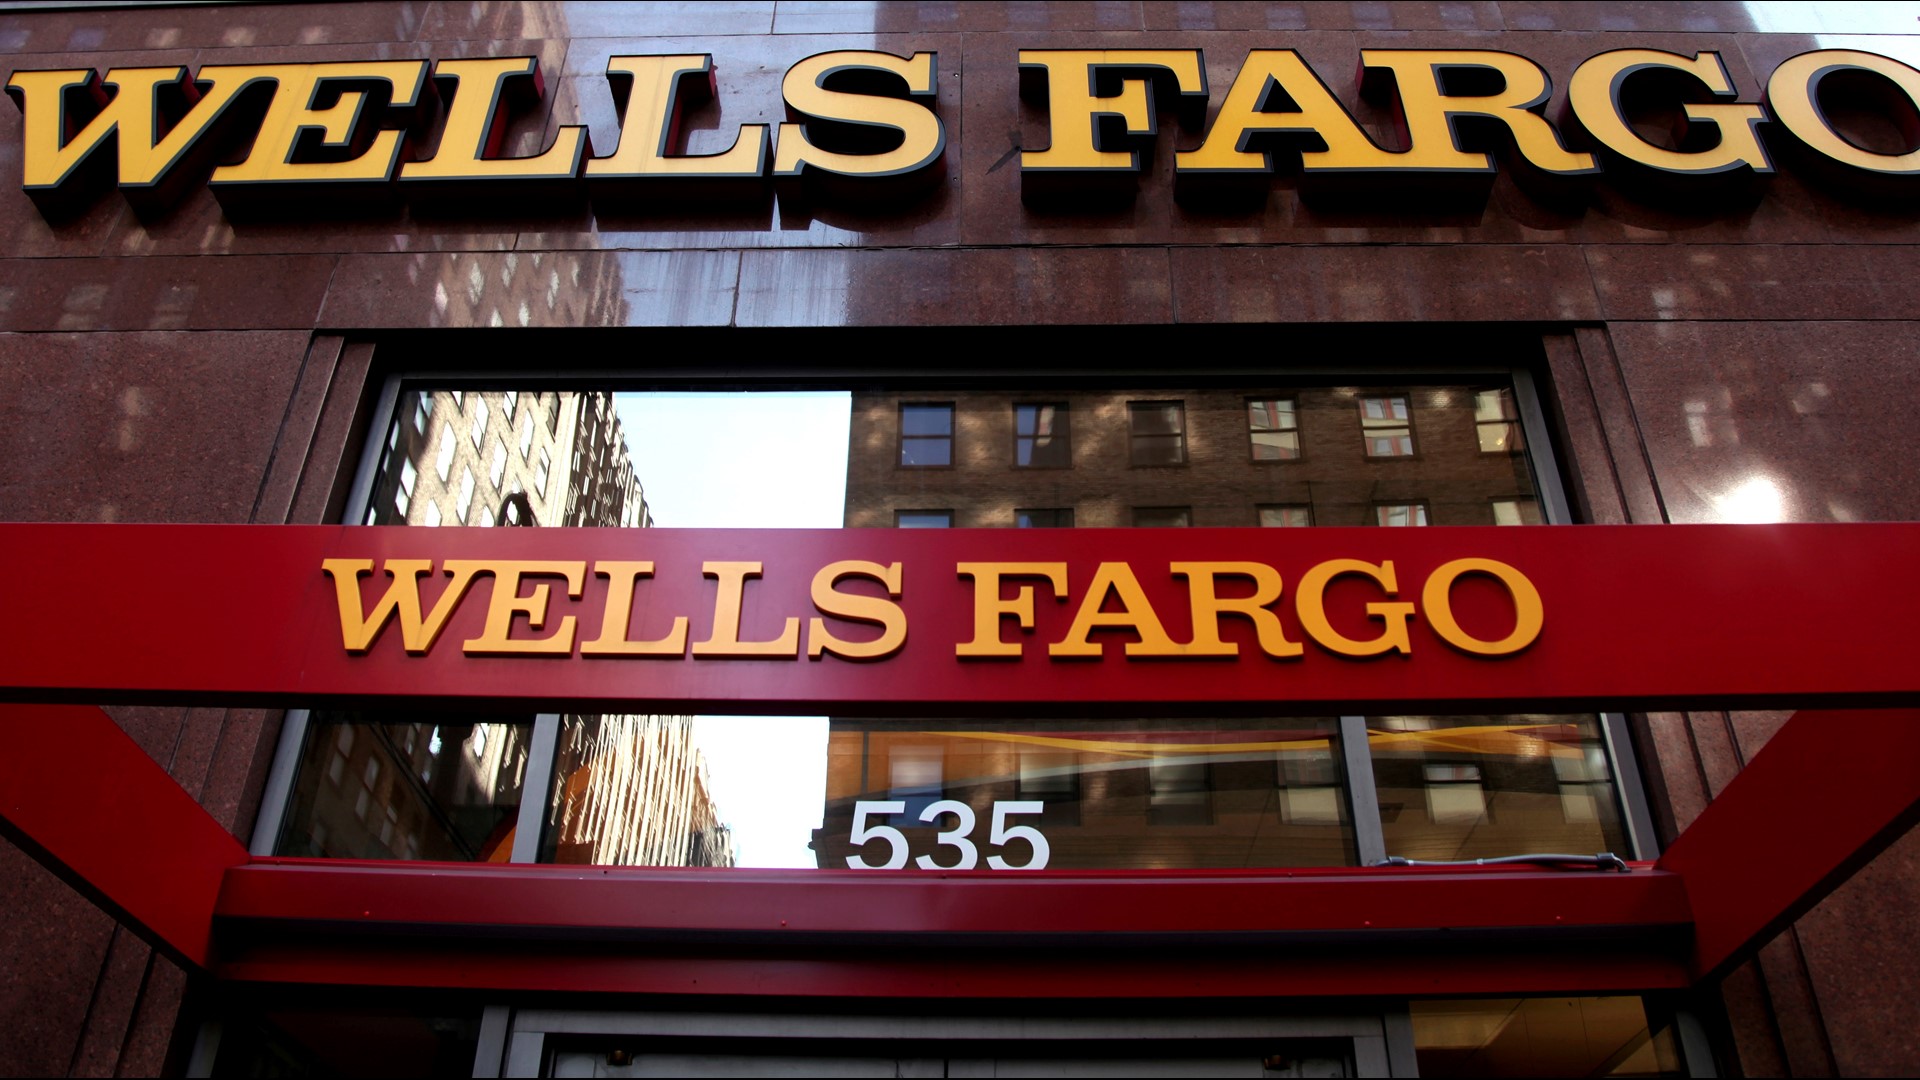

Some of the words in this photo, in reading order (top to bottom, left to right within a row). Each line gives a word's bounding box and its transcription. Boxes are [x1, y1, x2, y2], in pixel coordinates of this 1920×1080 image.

[6, 51, 946, 188] WELLS
[1018, 48, 1920, 177] FARGO
[322, 558, 906, 661] WELLS
[955, 557, 1545, 659] FARGO
[845, 799, 1051, 870] 535
